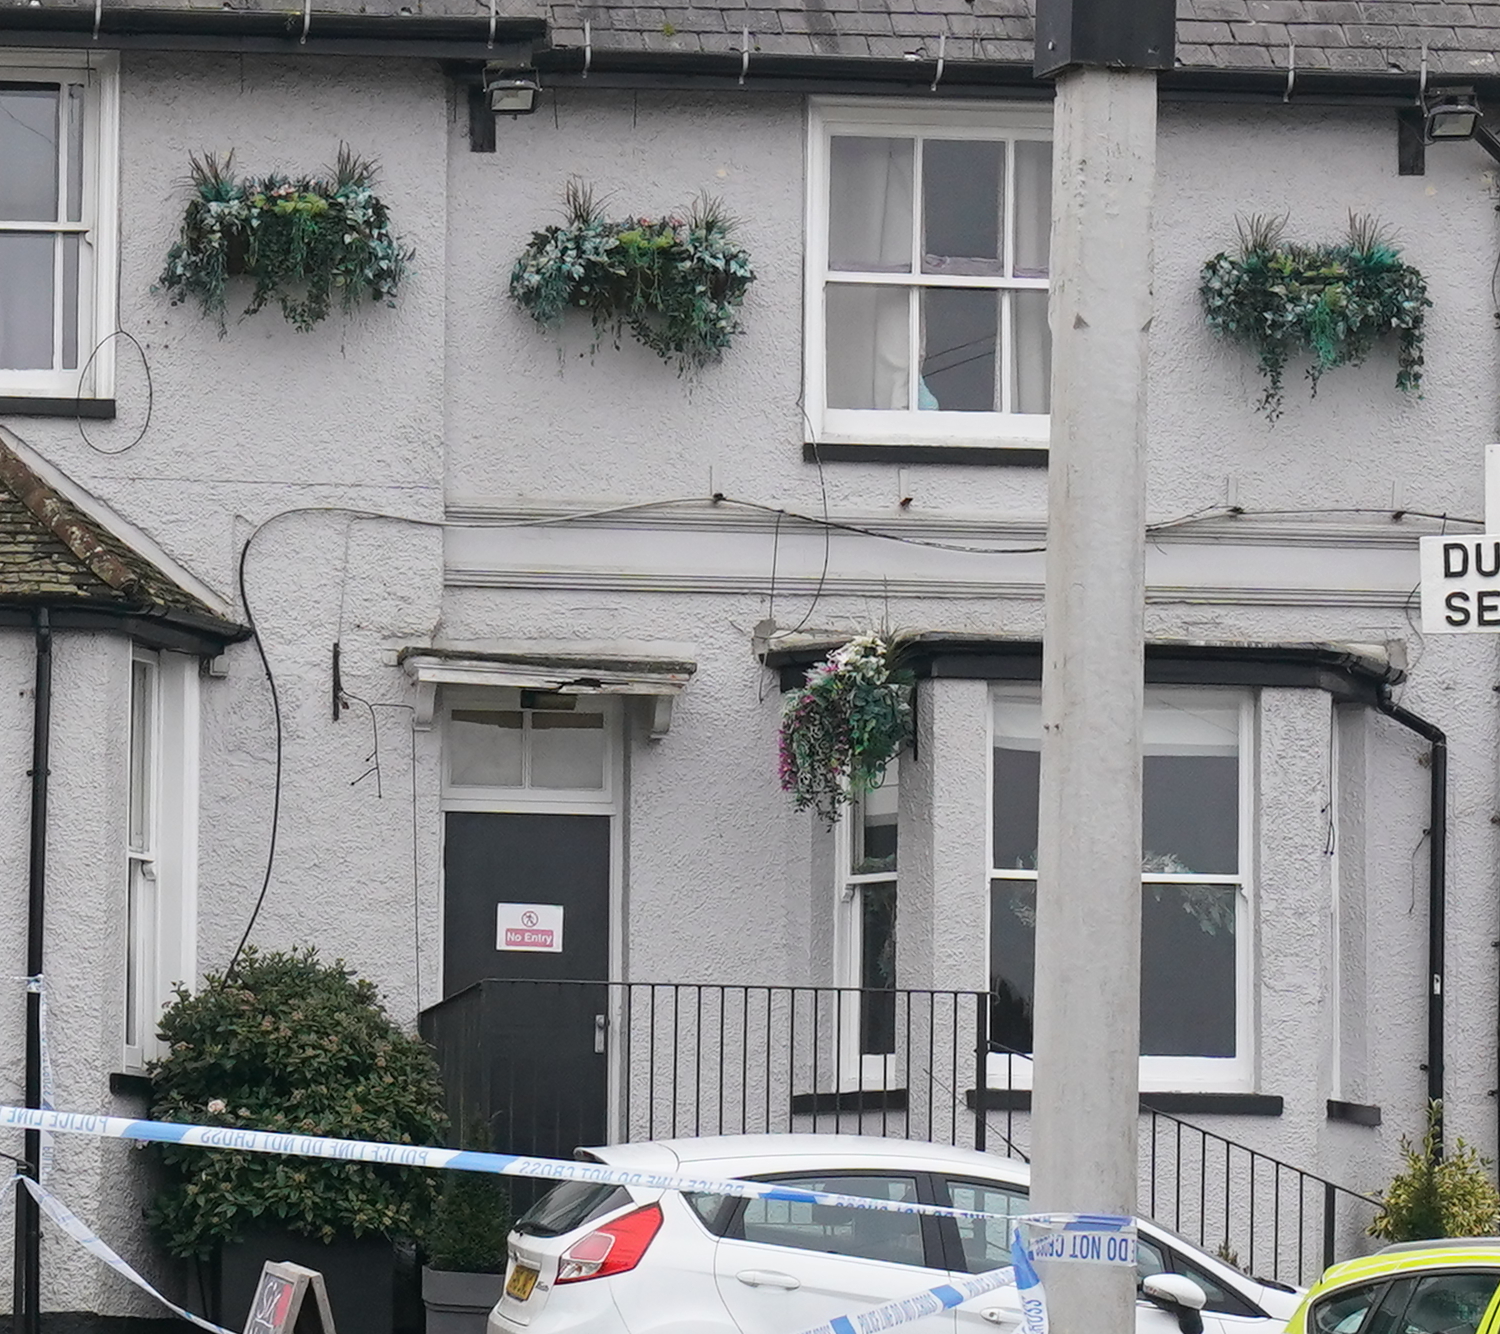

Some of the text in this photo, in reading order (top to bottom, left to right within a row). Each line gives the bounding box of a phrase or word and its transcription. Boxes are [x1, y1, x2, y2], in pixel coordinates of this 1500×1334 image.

[507, 931, 553, 945] No Entry
[1069, 1234, 1101, 1260] NOT
[1107, 1236, 1129, 1262] DO
